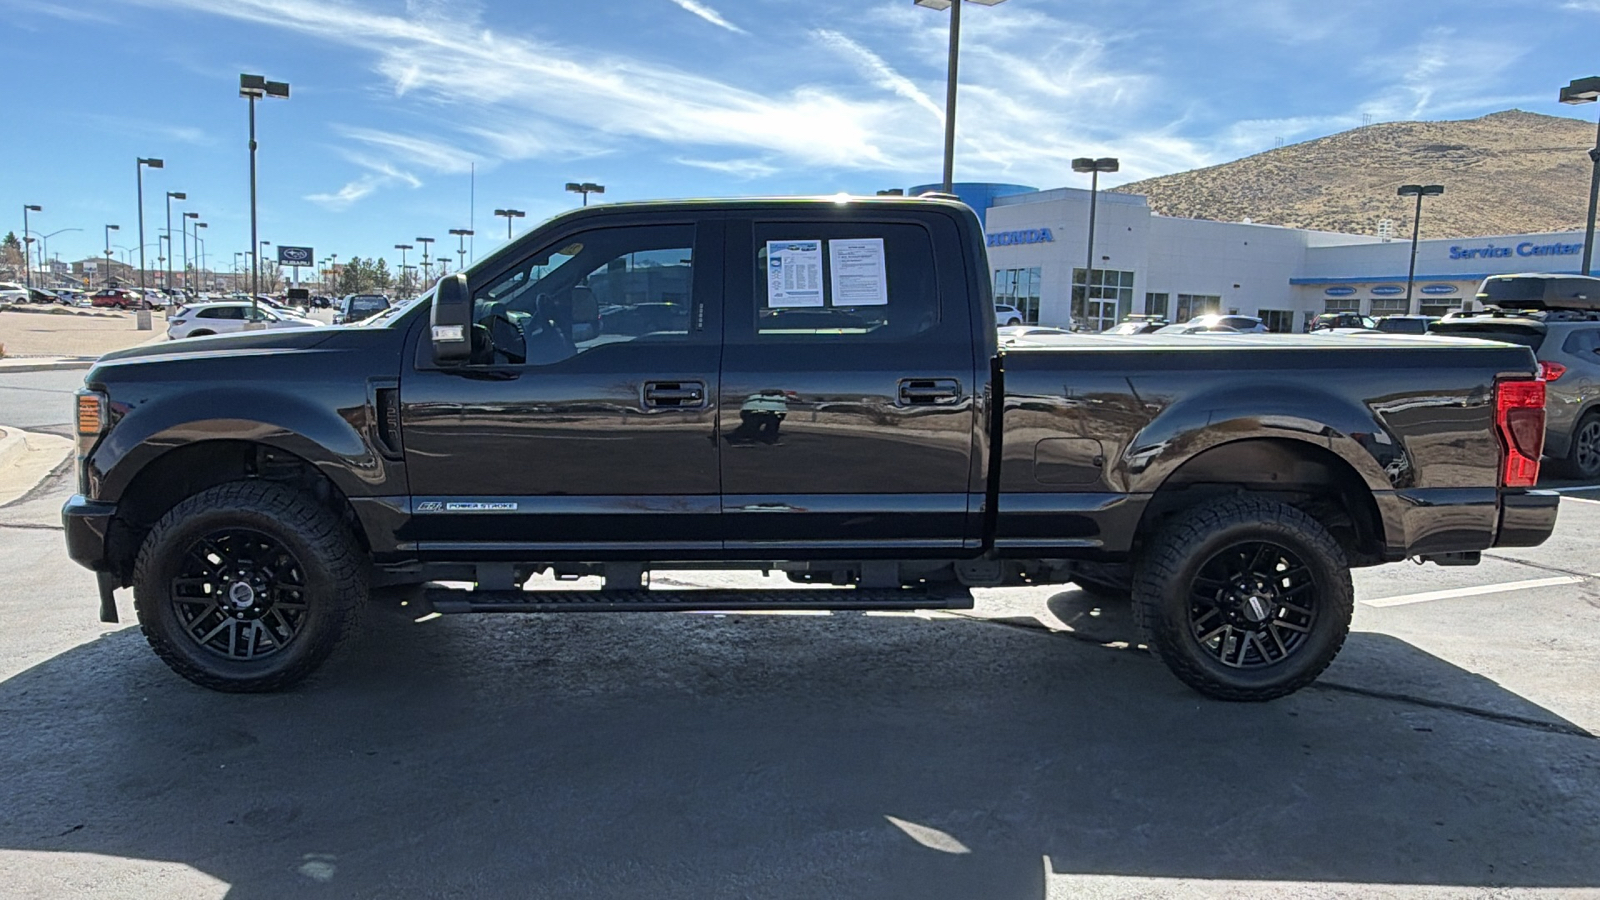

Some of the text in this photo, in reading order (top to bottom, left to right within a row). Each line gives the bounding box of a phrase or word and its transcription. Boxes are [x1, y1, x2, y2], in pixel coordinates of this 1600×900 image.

[986, 228, 1054, 247] HONDA
[1449, 242, 1583, 260] Service Center
